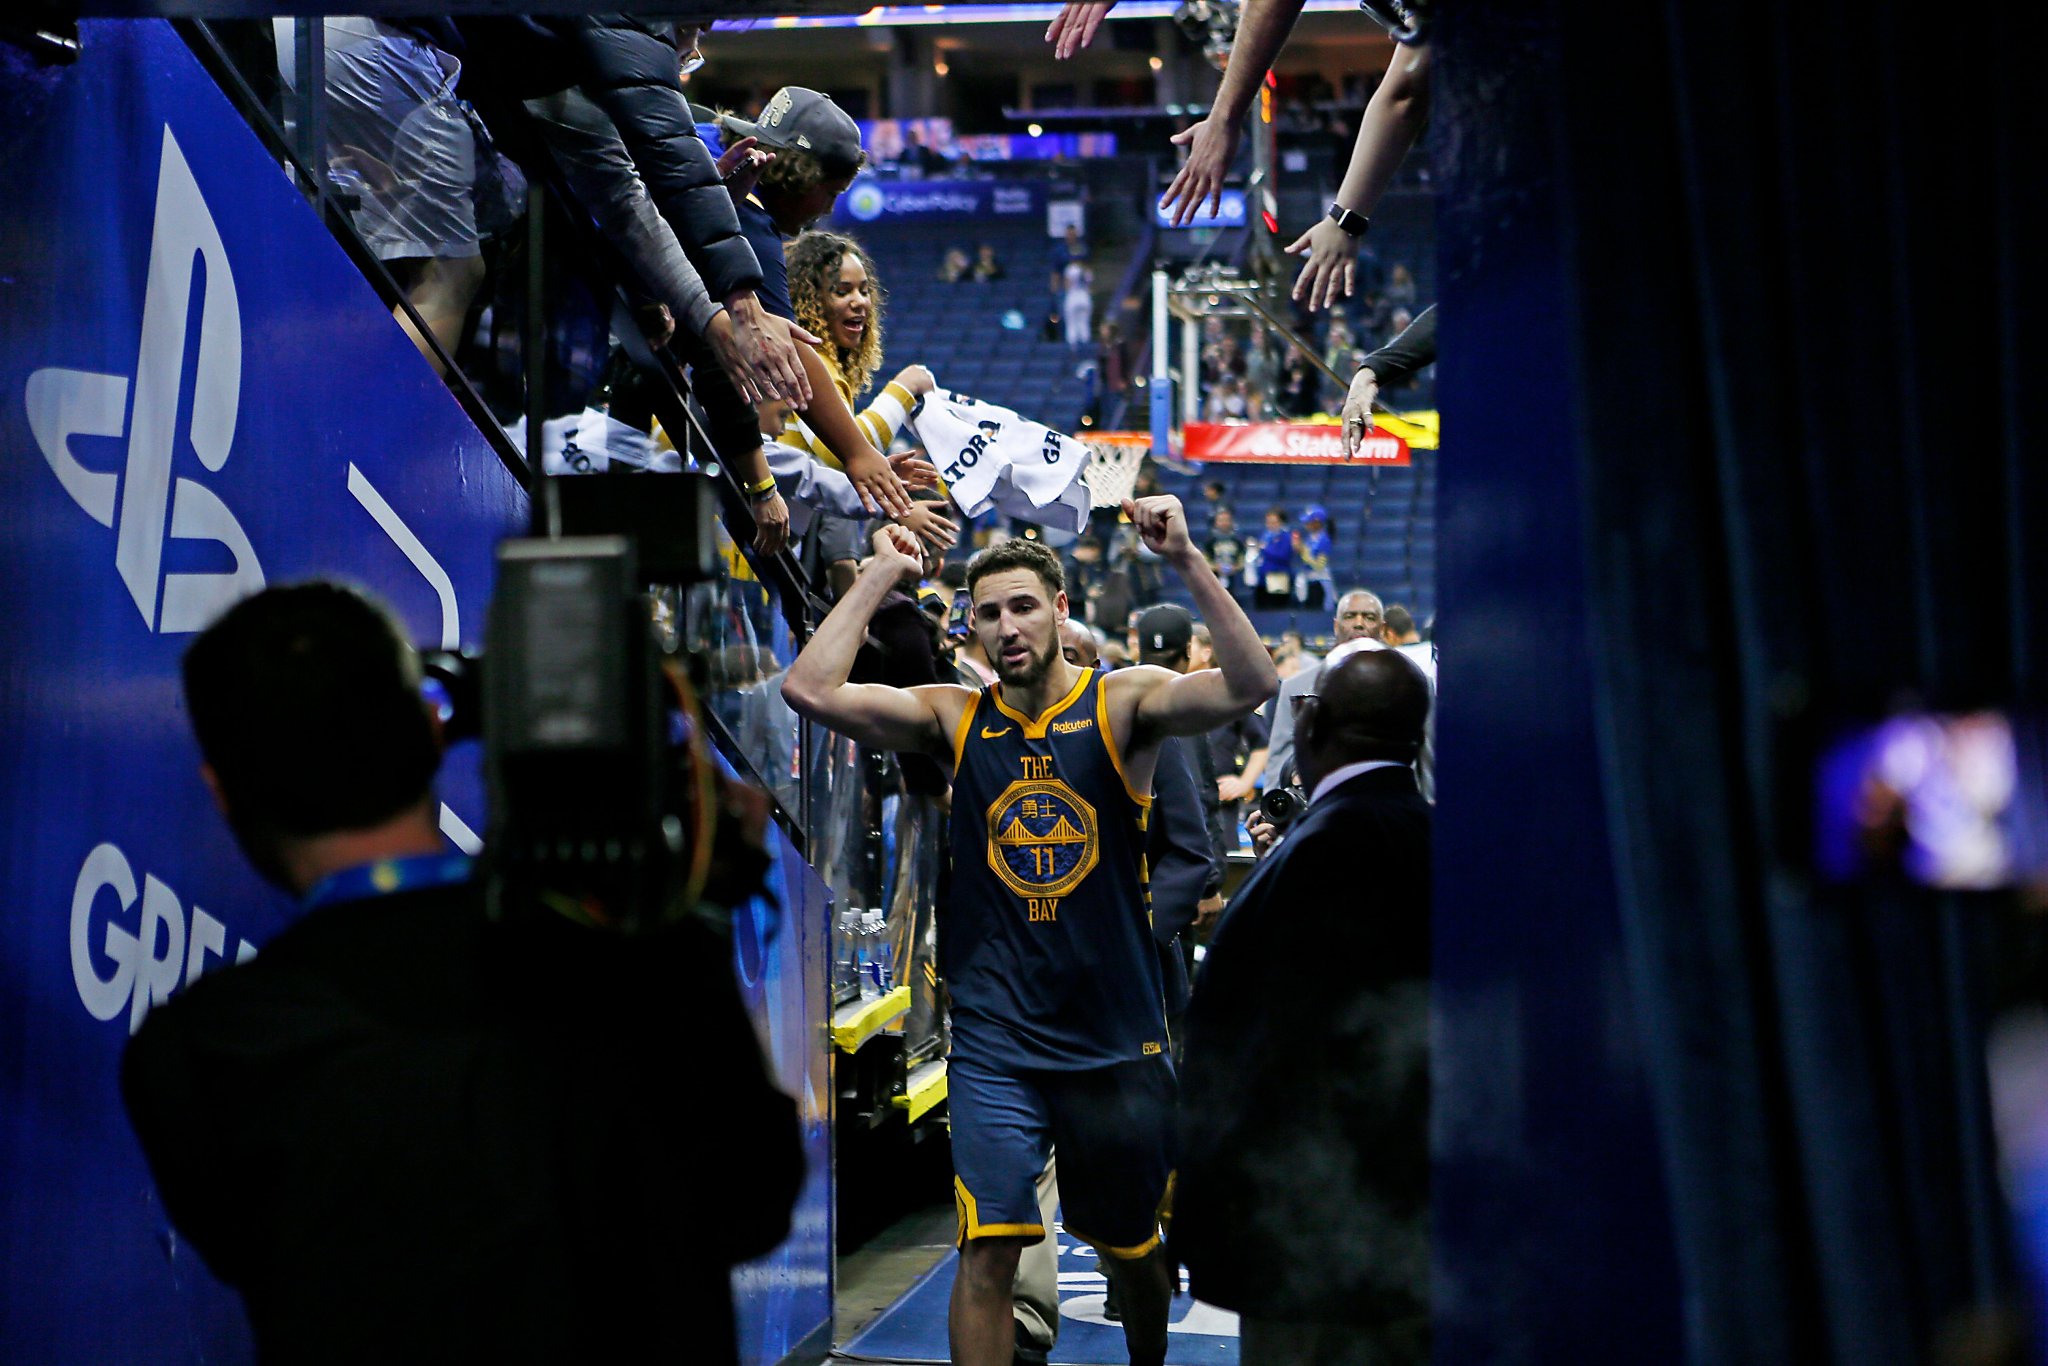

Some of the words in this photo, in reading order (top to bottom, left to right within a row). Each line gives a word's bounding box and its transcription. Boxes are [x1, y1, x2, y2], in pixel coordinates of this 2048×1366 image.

[1052, 718, 1093, 734] Rakuten
[1021, 756, 1053, 779] THE
[1021, 799, 1057, 818] 勇士
[1030, 847, 1054, 875] 11
[1028, 899, 1059, 921] BAY
